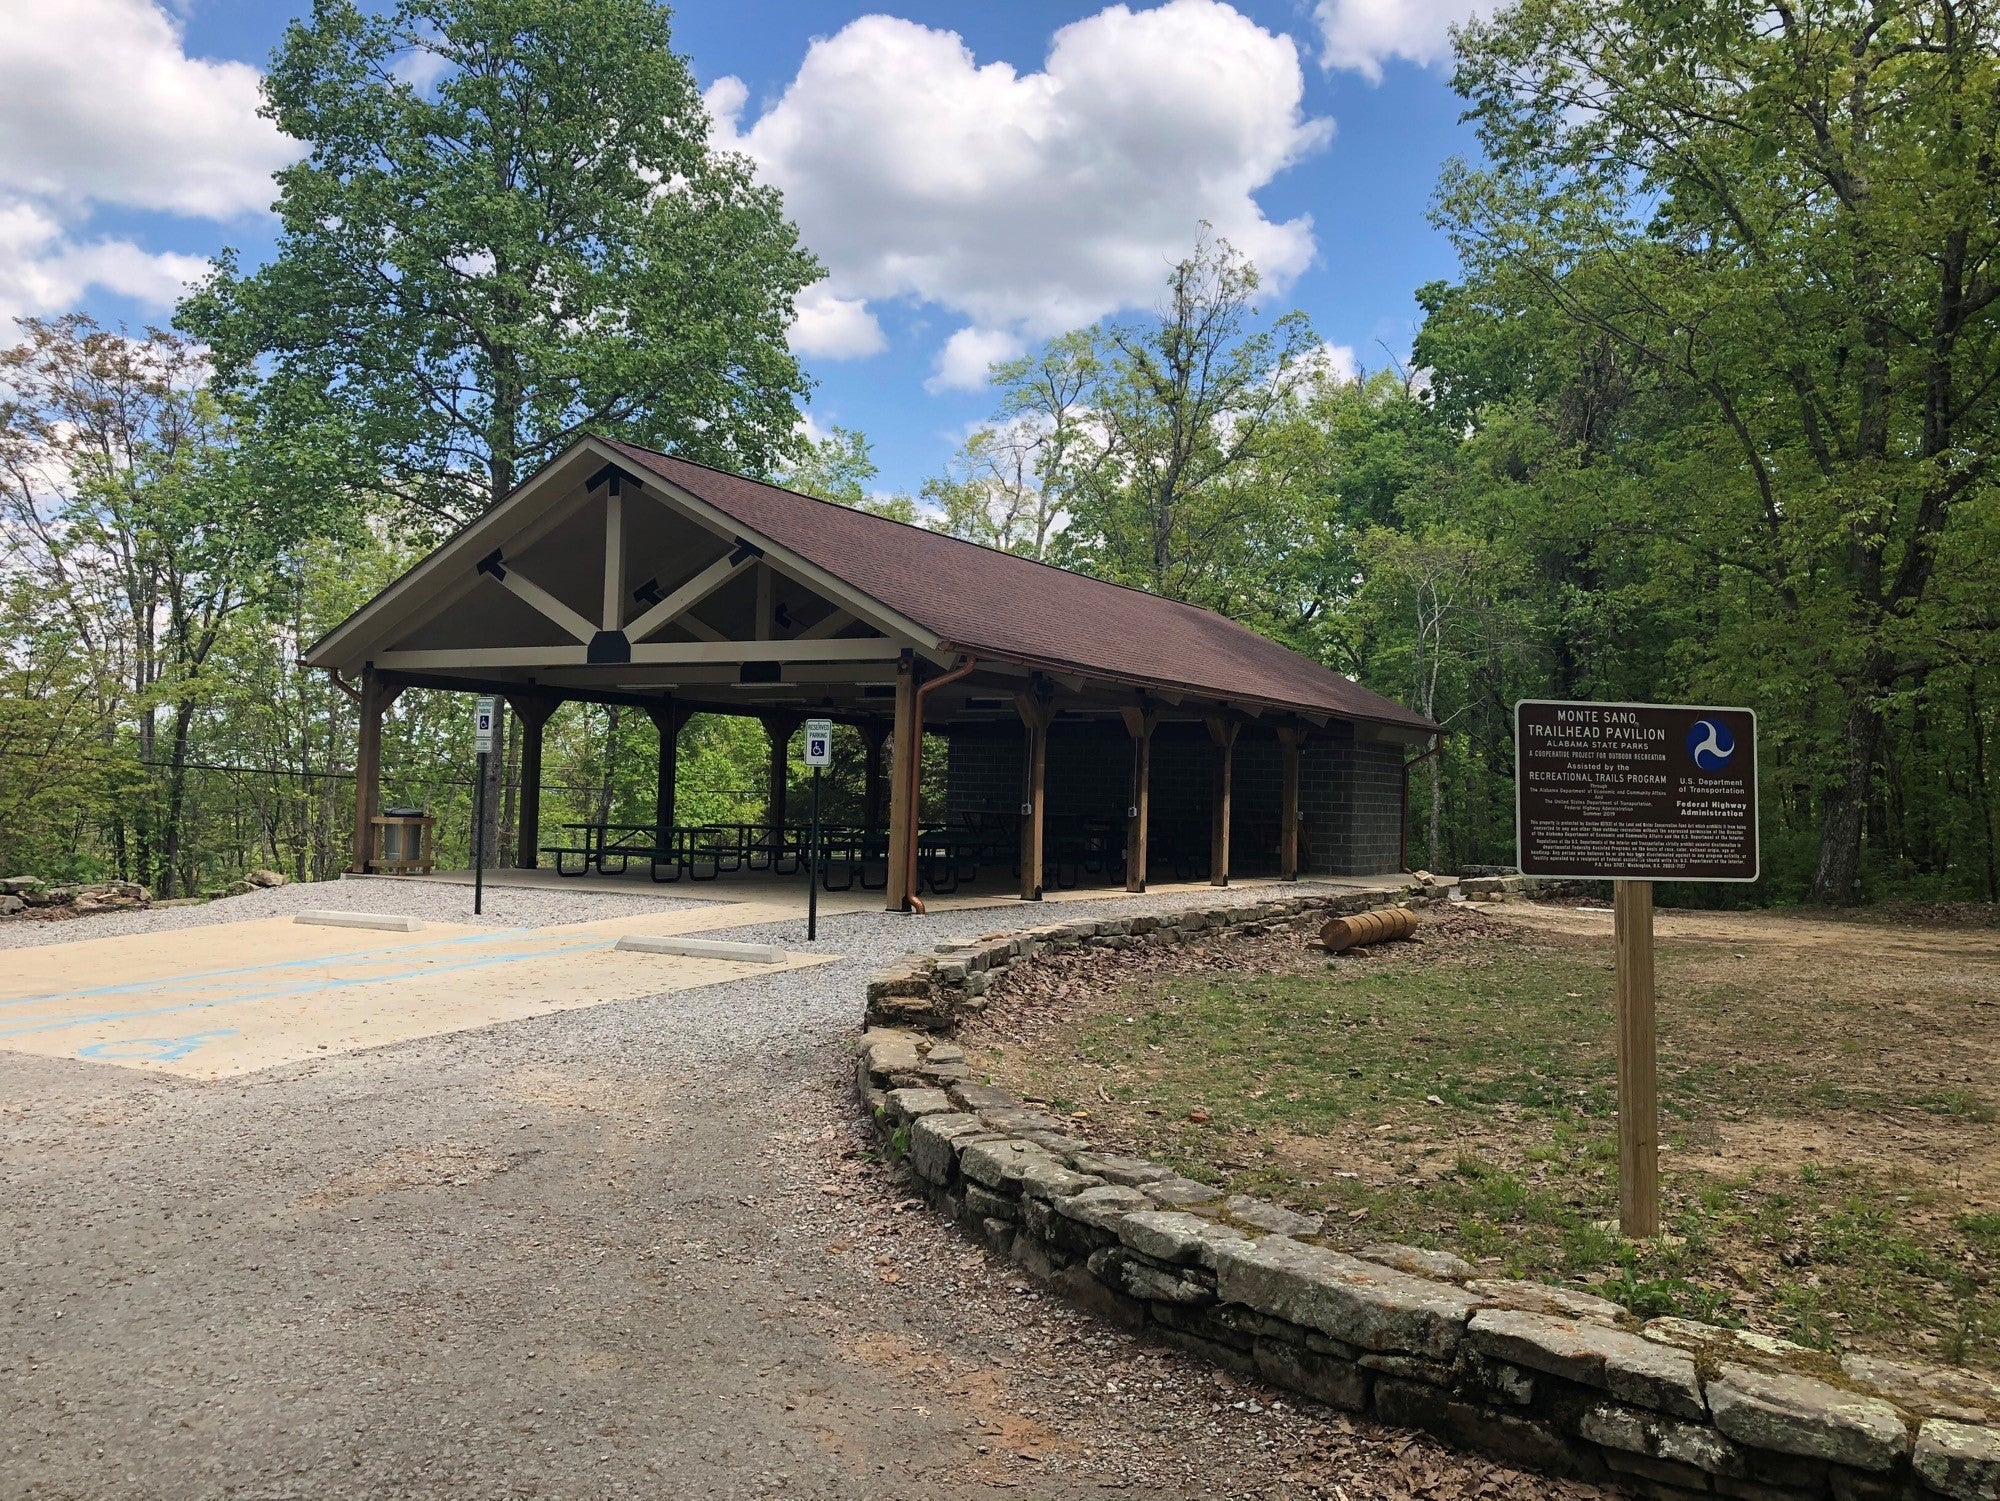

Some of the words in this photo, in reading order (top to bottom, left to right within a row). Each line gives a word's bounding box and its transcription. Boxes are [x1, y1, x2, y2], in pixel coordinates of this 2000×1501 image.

[1558, 710, 1598, 722] MONTE
[1604, 712, 1636, 724] SANO
[1528, 725, 1600, 738] TRAILHEAD
[1606, 727, 1665, 740] PAVILION
[1546, 740, 1588, 748] ALABAMA
[1529, 771, 1592, 781] RECREATIONAL
[1596, 773, 1624, 782] TRAILS
[1627, 774, 1667, 783] PROGRAM
[1712, 801, 1747, 810] Highway
[1681, 809, 1744, 817] Administration
